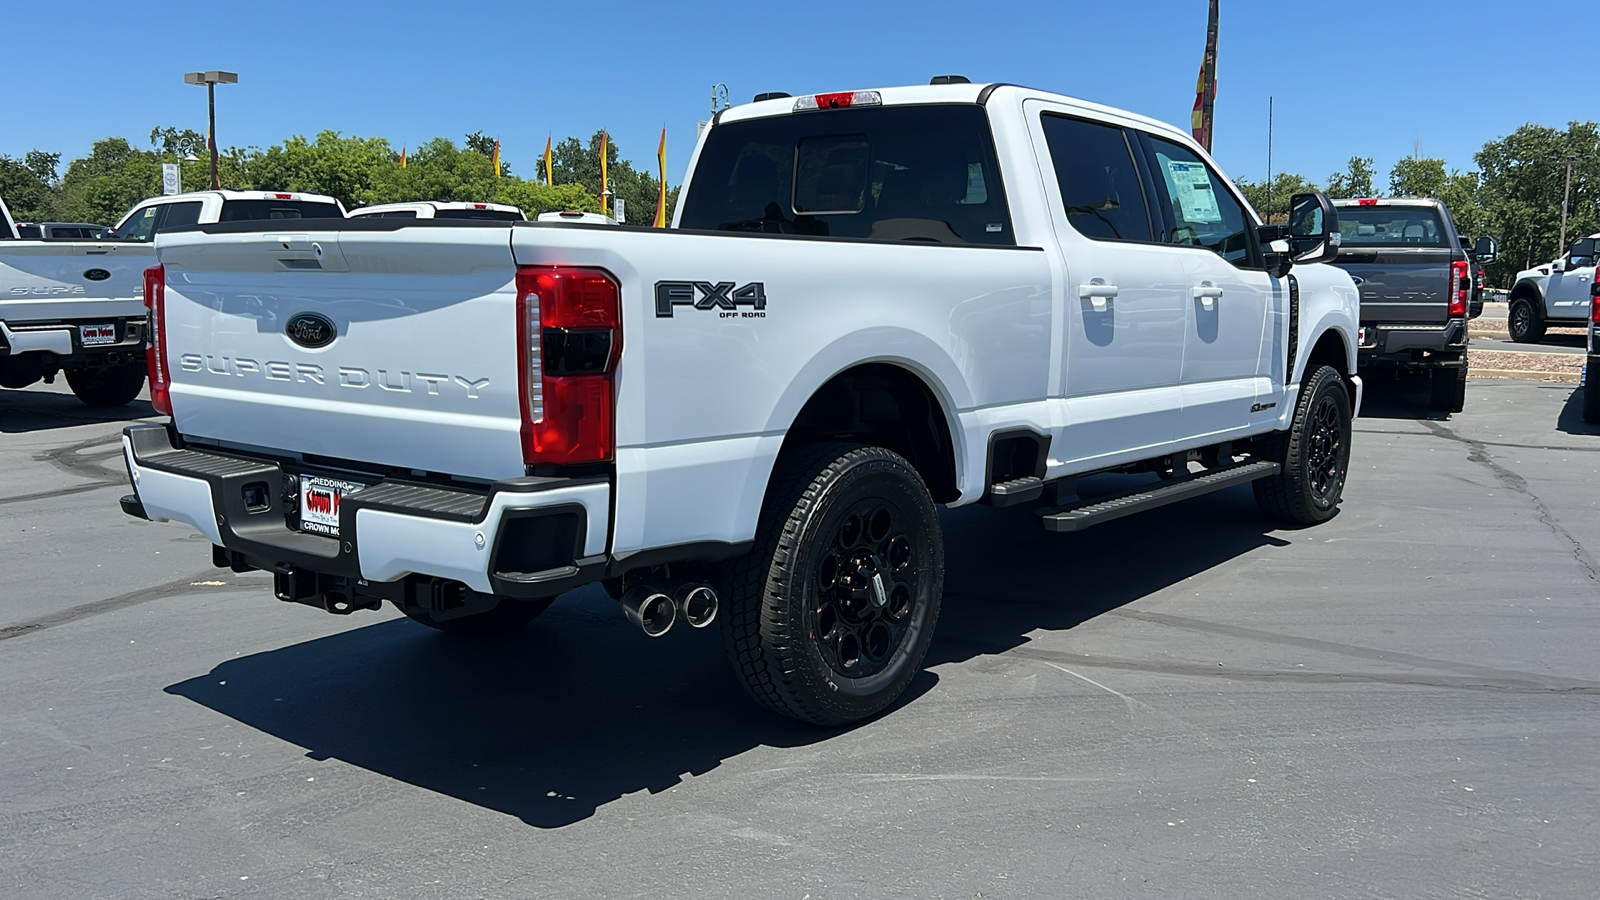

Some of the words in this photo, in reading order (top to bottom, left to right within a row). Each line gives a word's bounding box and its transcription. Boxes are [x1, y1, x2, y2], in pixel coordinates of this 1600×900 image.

[10, 286, 86, 296] SUPE
[654, 280, 767, 318] FX4
[293, 318, 323, 340] Ford
[180, 352, 325, 385] SUPER
[339, 366, 490, 399] DUTY
[314, 477, 349, 490] REDDING
[304, 521, 329, 534] CROWN
